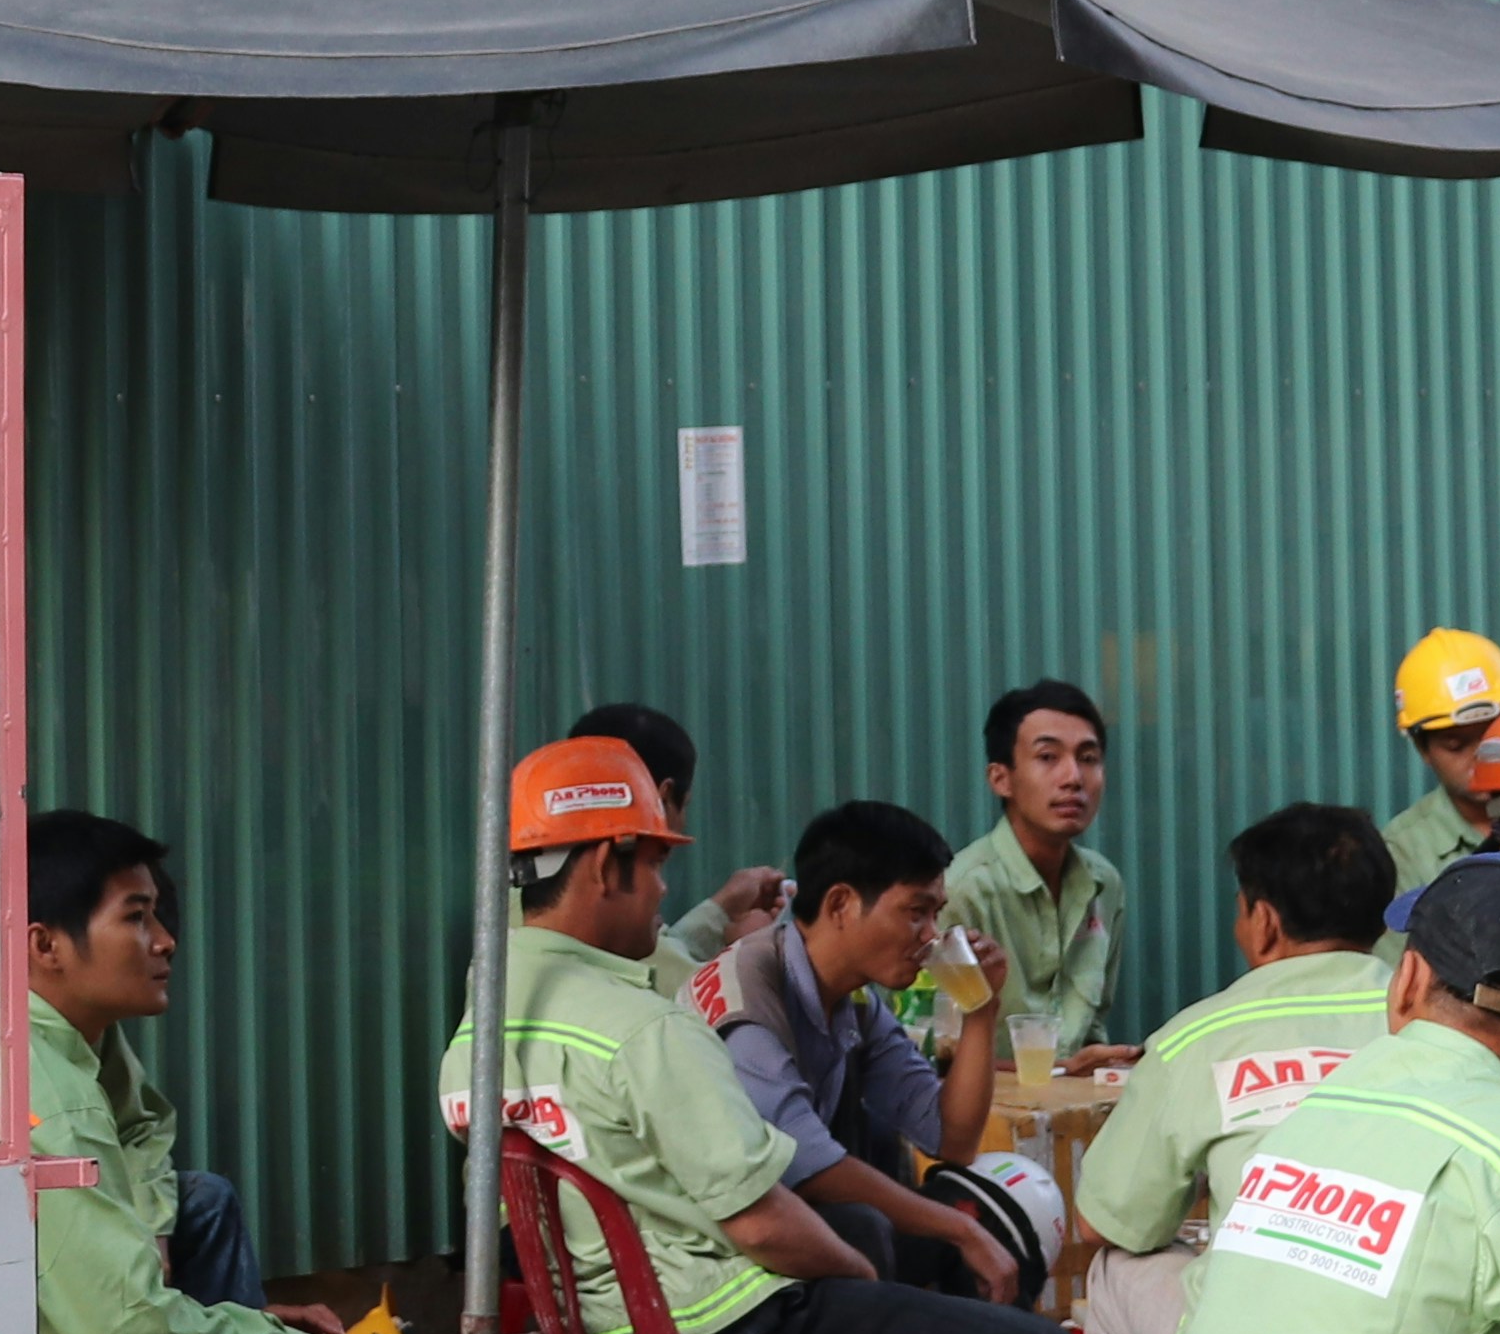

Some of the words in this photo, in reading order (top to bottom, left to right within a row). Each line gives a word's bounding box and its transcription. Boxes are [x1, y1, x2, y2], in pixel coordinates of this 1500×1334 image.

[1227, 1057, 1306, 1100] An
[1257, 1161, 1407, 1256] Phong
[1267, 1212, 1358, 1248] CONSTRUCTION
[1286, 1246, 1308, 1261] ISO
[1309, 1252, 1379, 1287] 9001:2008
